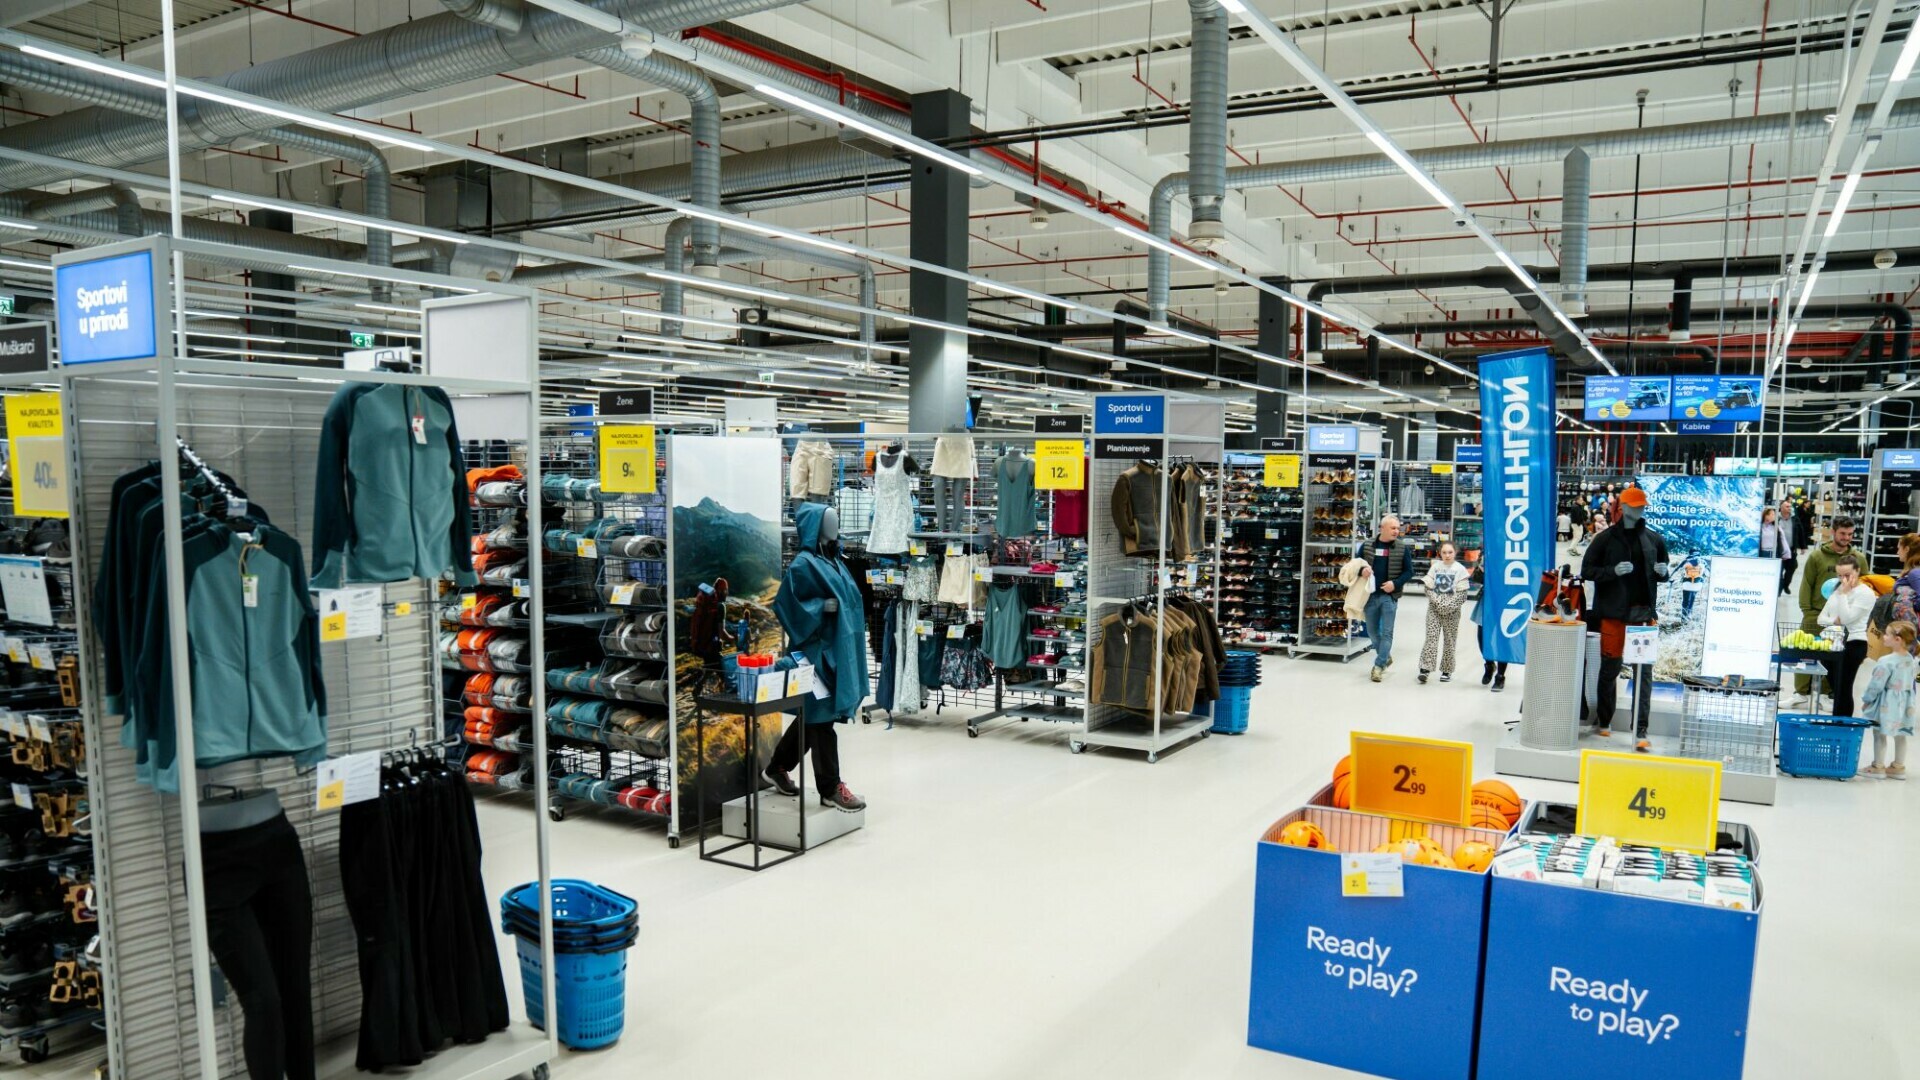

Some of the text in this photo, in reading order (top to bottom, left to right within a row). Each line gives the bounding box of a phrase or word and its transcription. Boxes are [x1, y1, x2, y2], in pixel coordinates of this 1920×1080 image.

[77, 280, 128, 313] Sportovi
[79, 307, 129, 338] u prirodi
[0, 338, 35, 355] Muškarci
[616, 395, 634, 406] Žene
[1108, 403, 1143, 413] Sportovi
[27, 419, 54, 429] KVALITETA
[1051, 418, 1067, 426] Žene
[1115, 415, 1143, 425] prirodi
[1106, 444, 1151, 453] Planinarenje
[1669, 505, 1697, 514] biste
[1647, 518, 1688, 526] onovno
[1713, 587, 1762, 596] Otkupljujemo
[1731, 598, 1764, 606] sportsku
[1712, 605, 1741, 613] opremu
[1307, 925, 1391, 967] Ready
[1324, 960, 1418, 998] to play?
[1550, 966, 1649, 1012] Ready
[1569, 1002, 1680, 1044] to play?
